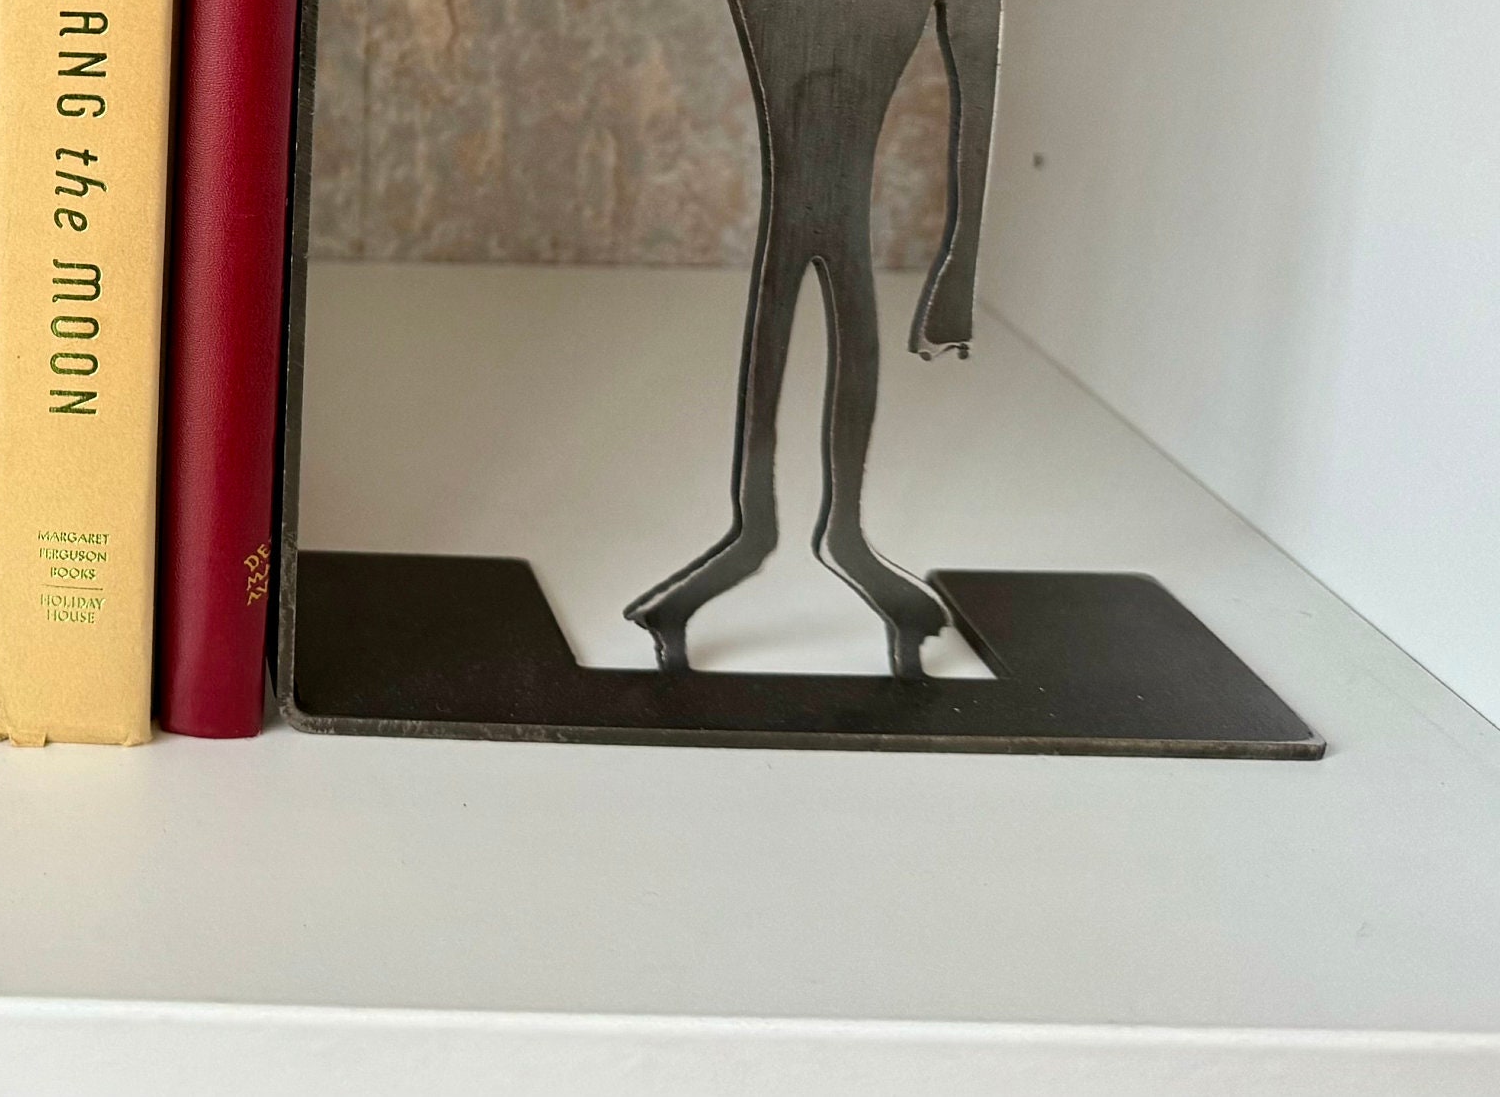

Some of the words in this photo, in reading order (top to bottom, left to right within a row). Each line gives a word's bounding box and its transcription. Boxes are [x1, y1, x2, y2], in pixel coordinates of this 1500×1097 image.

[53, 147, 108, 233] the
[49, 258, 102, 415] MOON
[37, 530, 110, 545] MARGARET
[39, 547, 108, 562] FERGUSON
[50, 566, 97, 580] BOOKS
[40, 593, 106, 610] HOLIDAY
[46, 608, 96, 624] HOUSE
